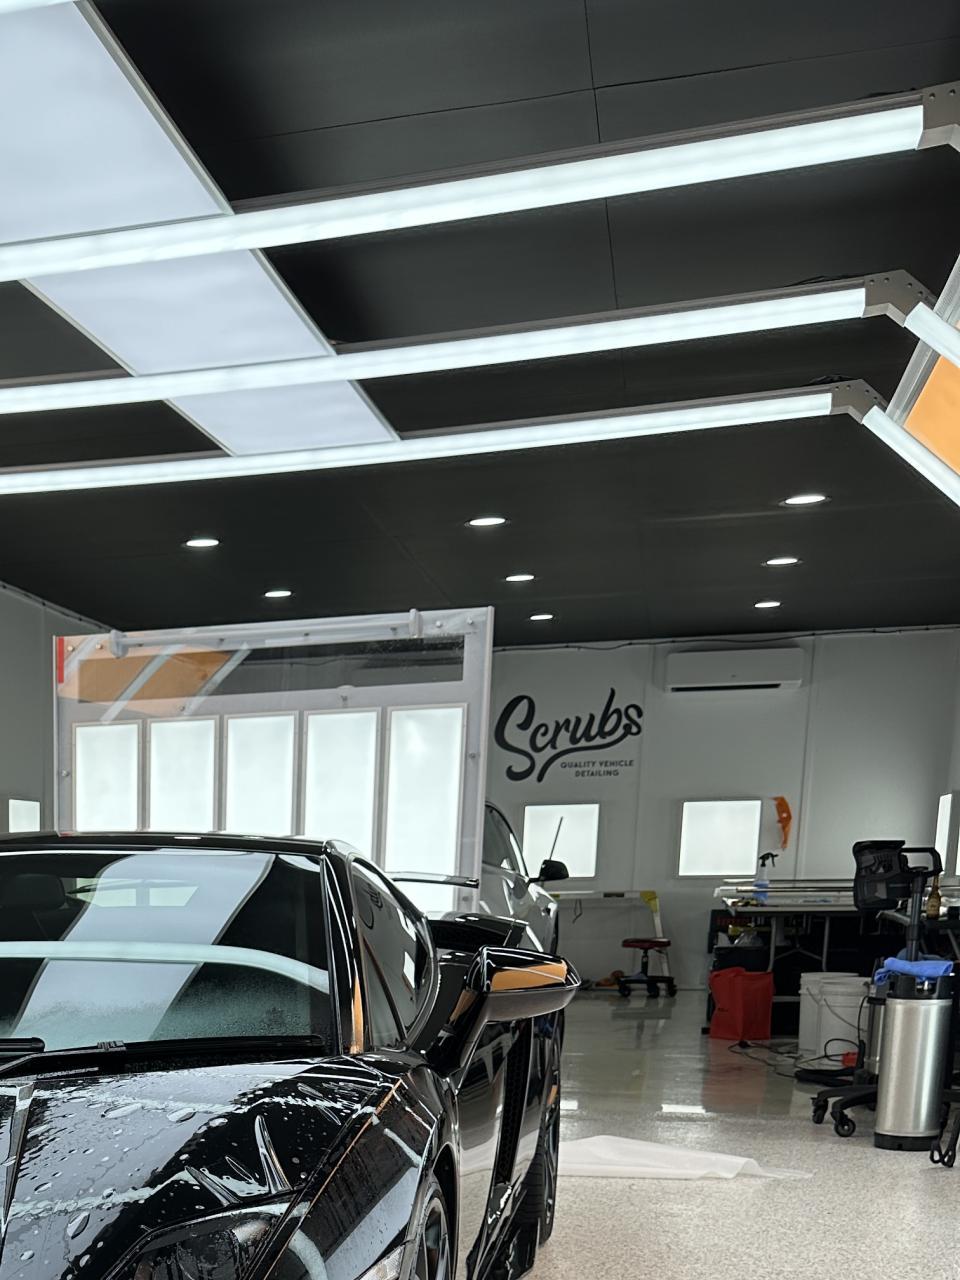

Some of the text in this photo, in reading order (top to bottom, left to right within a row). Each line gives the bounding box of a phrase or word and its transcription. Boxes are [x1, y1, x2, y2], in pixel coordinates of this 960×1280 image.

[494, 687, 644, 782] Scrubs
[560, 759, 635, 769] QUALITY VEHICLE
[575, 769, 620, 777] DETAILING
